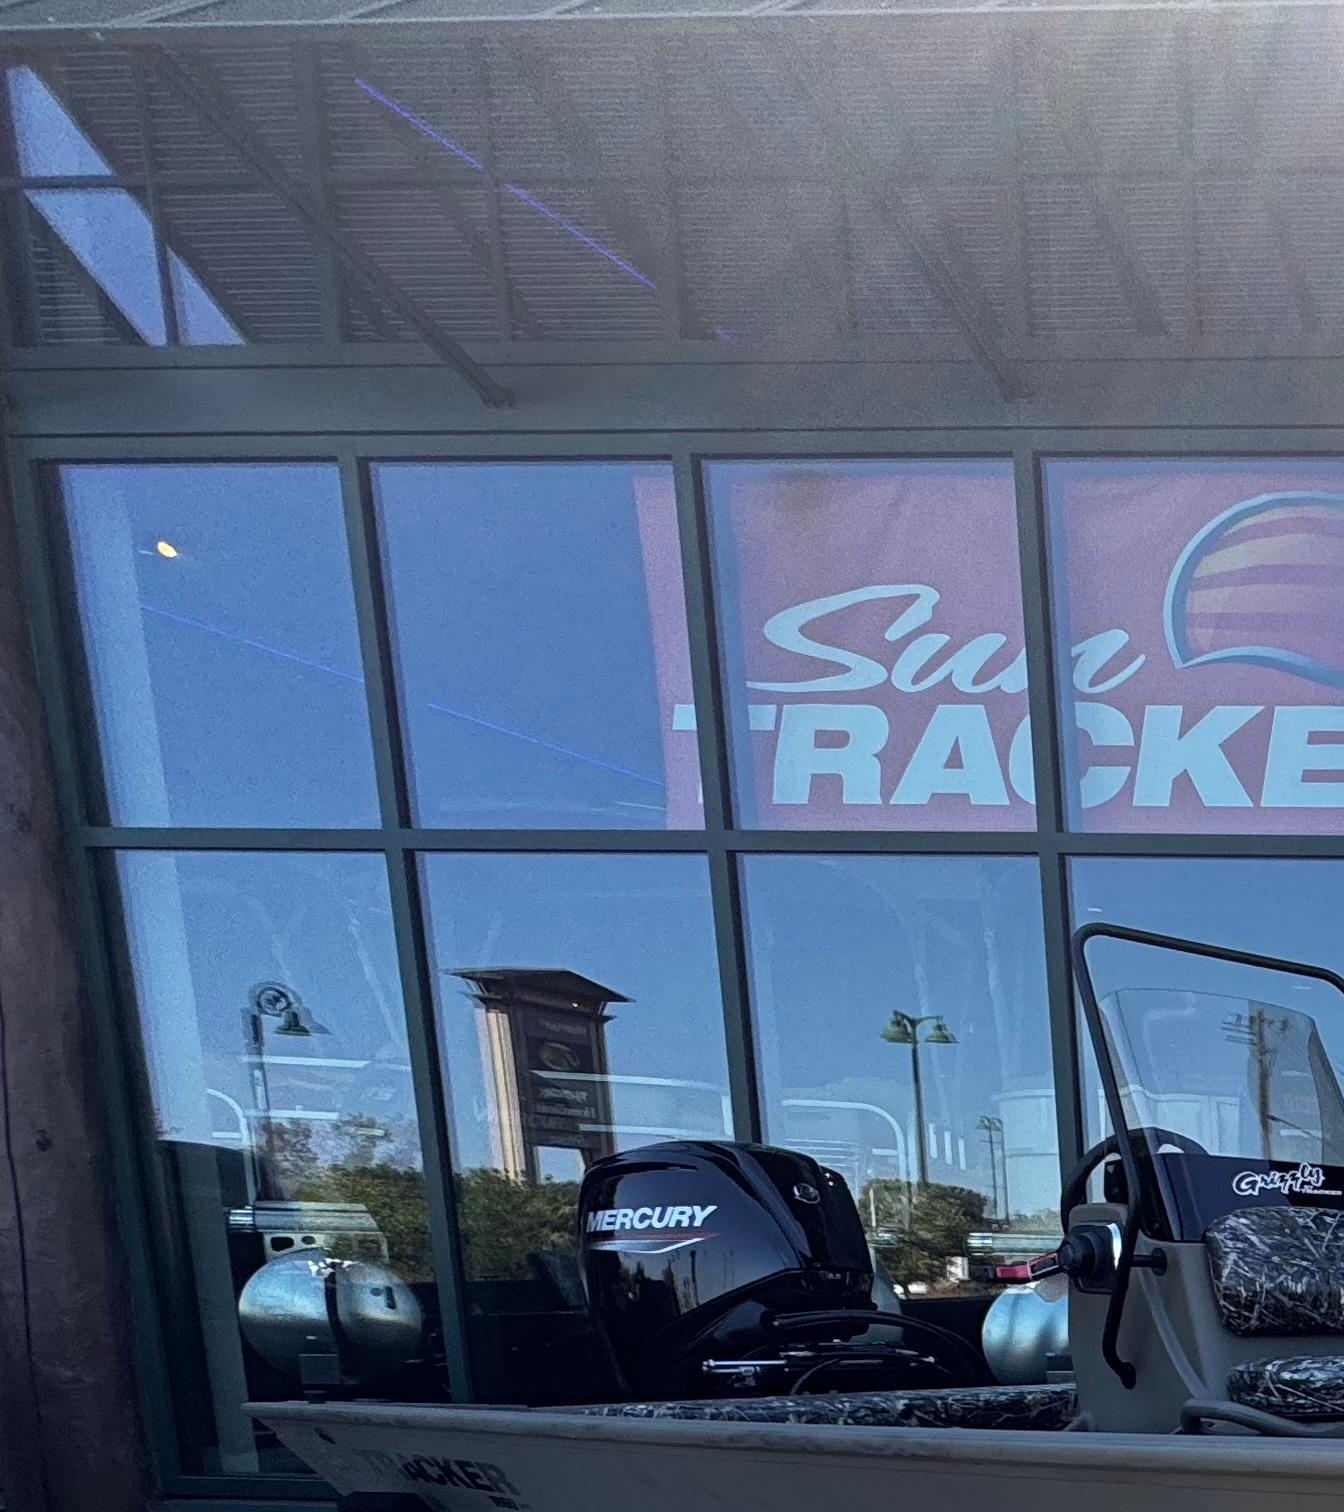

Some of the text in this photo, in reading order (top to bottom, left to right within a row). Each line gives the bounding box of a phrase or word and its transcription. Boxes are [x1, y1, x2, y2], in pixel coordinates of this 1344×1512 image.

[746, 583, 1146, 694] Sun
[1232, 1162, 1326, 1196] Grizzly
[586, 1205, 718, 1233] MERCURY
